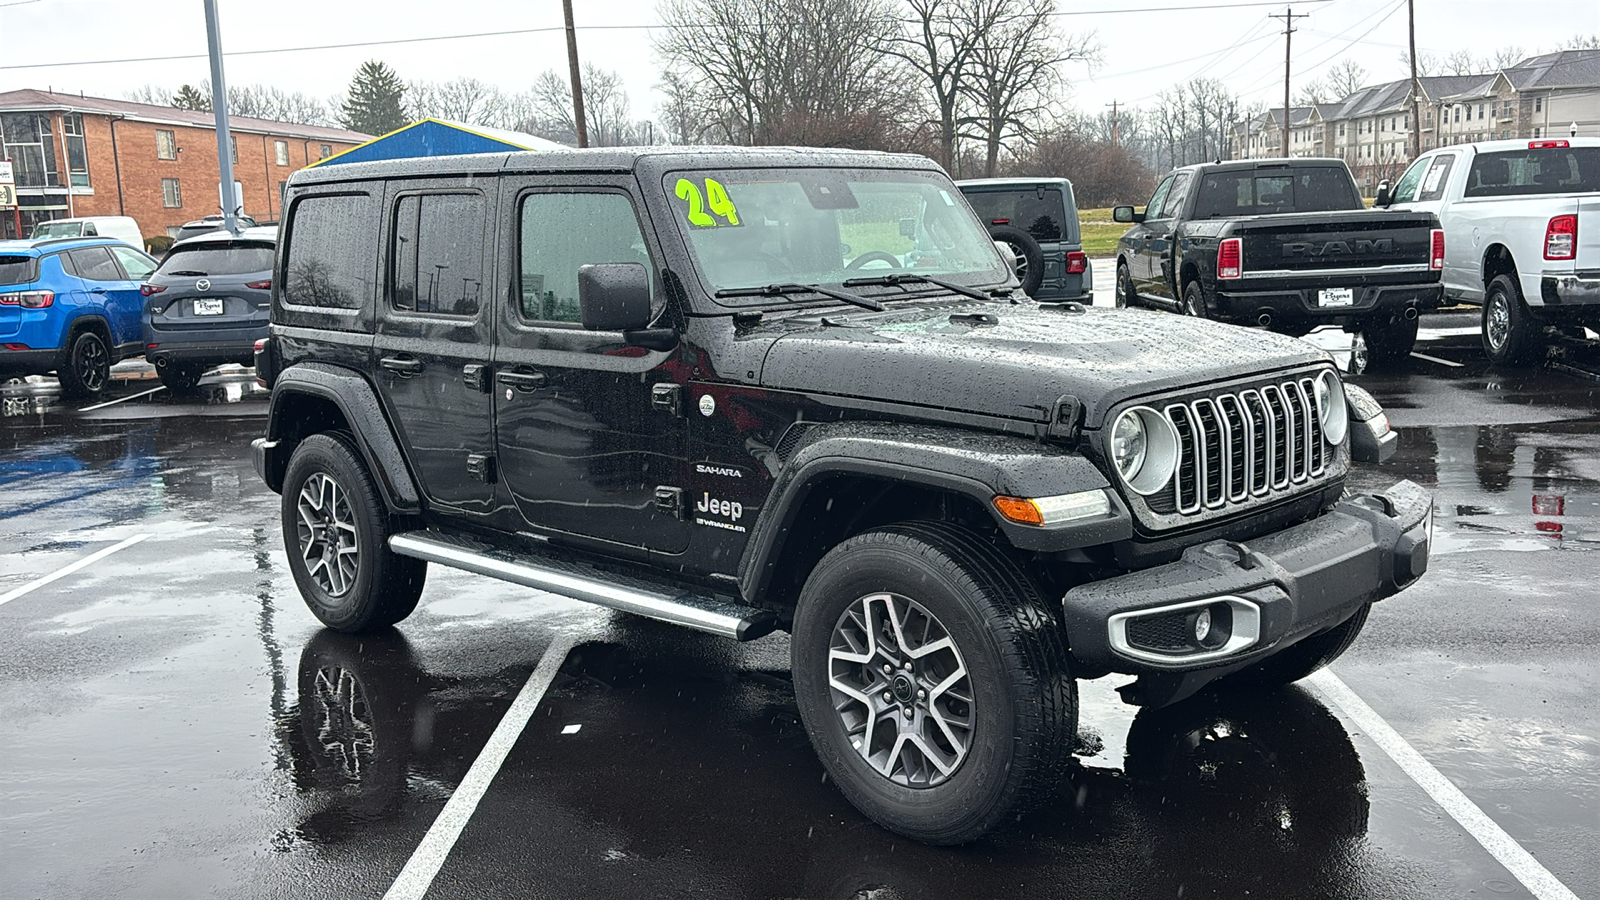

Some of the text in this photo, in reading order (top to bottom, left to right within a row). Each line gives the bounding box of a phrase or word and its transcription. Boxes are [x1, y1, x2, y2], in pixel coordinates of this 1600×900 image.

[675, 178, 739, 227] 24
[1282, 239, 1392, 257] RAM
[696, 465, 742, 477] SAHARA
[697, 492, 743, 521] Jeep
[703, 518, 746, 533] WRANGLER
